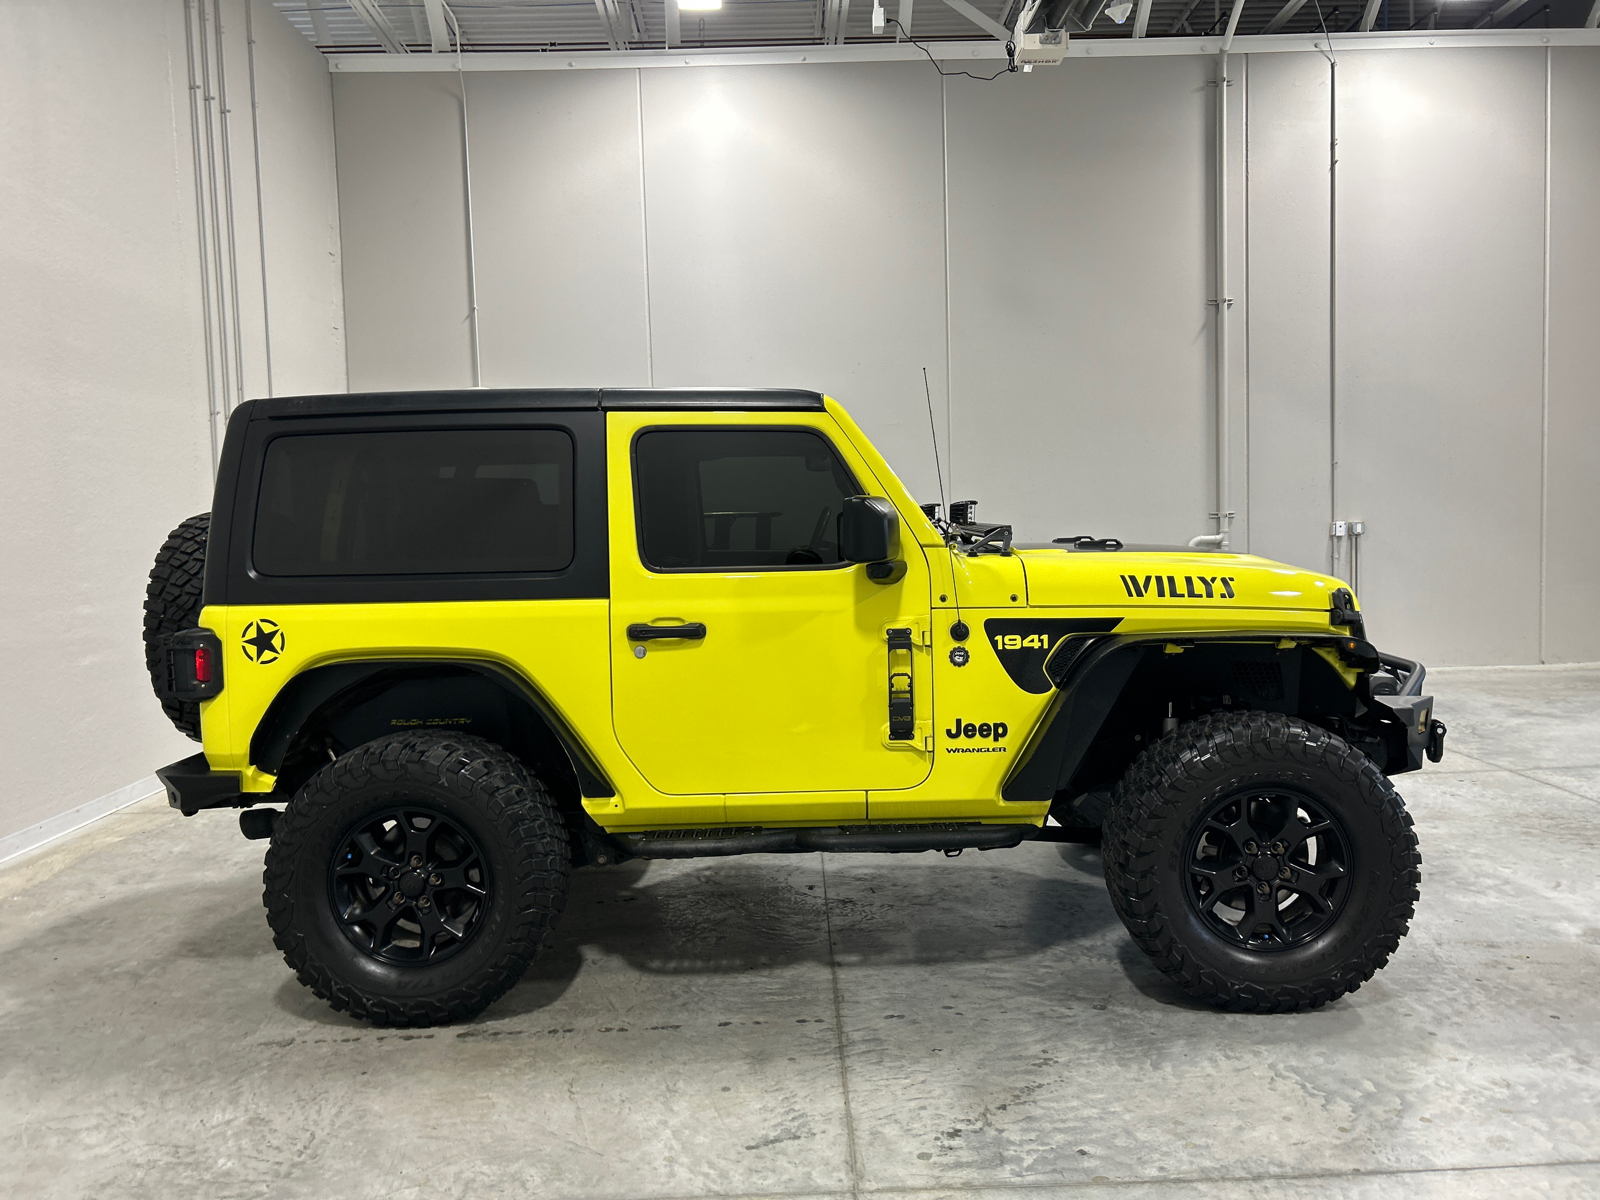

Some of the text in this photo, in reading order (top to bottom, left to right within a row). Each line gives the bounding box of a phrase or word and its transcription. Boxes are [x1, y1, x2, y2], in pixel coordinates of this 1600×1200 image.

[1119, 574, 1235, 599] WILLYS
[994, 634, 1049, 650] 1941
[945, 718, 1008, 742] Jeep
[945, 746, 1007, 754] WRANGLER
